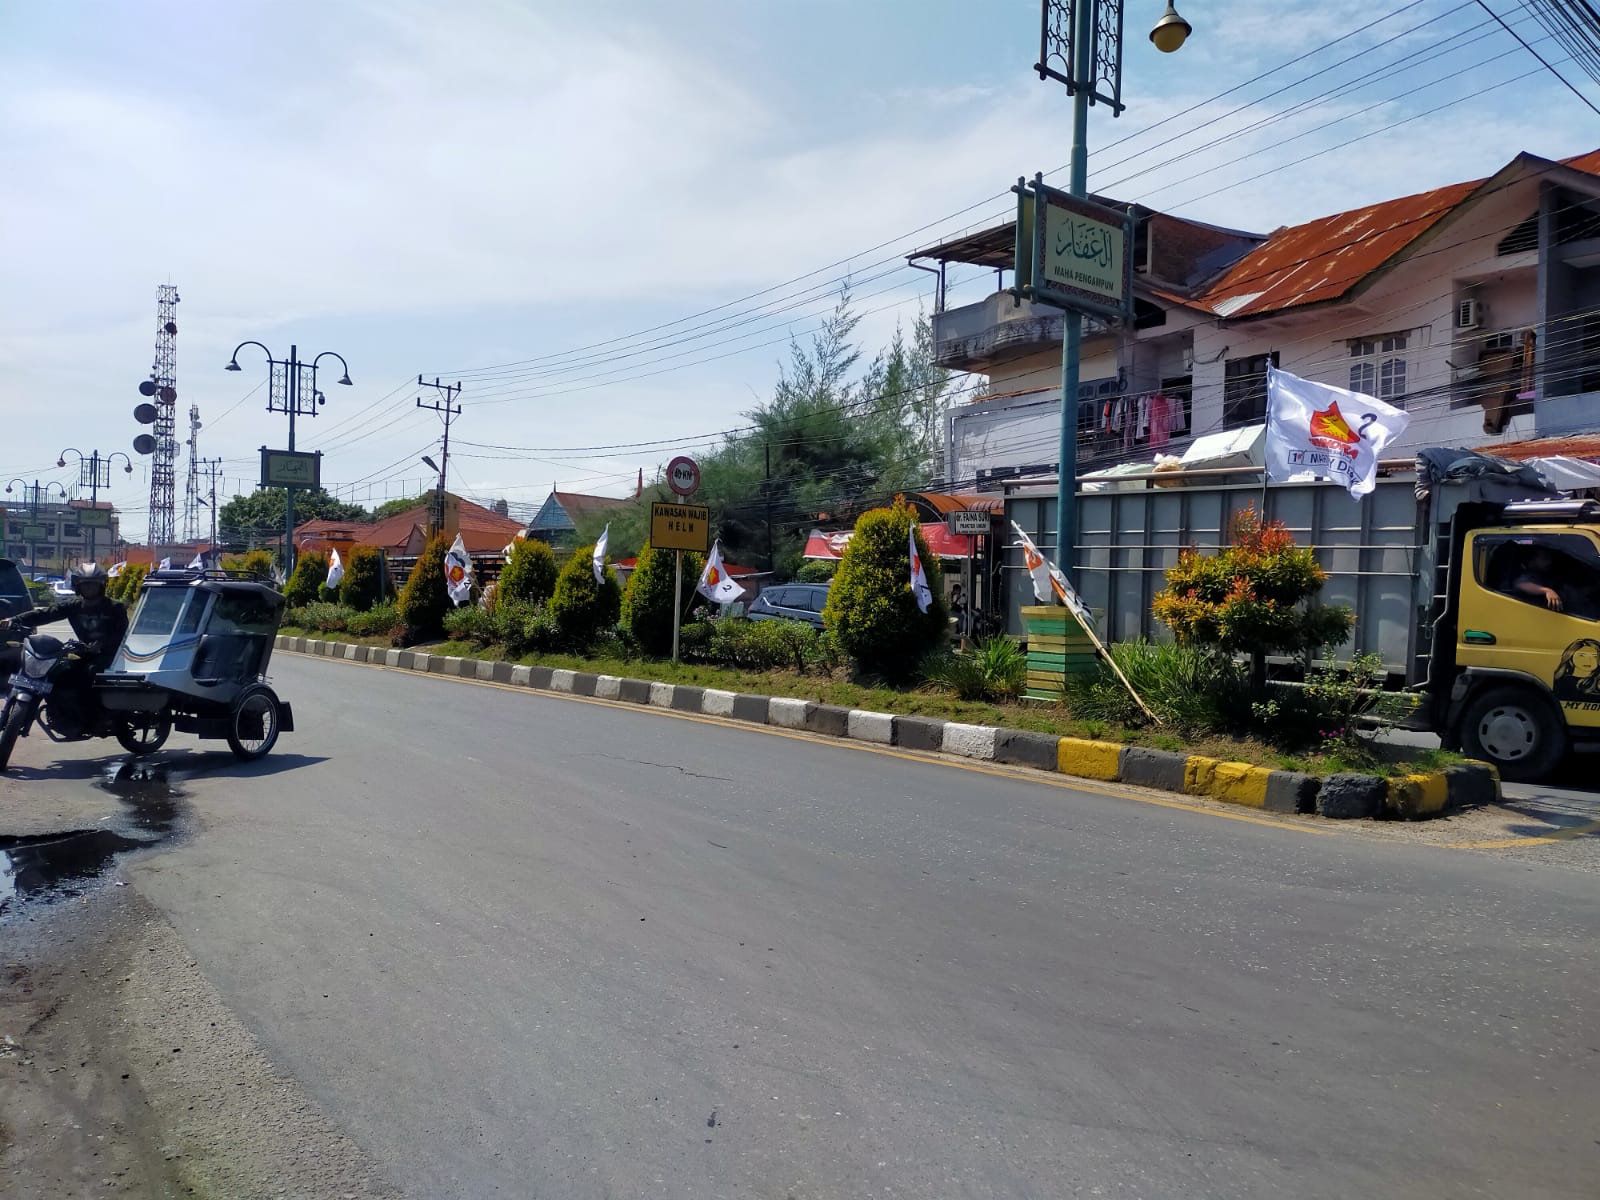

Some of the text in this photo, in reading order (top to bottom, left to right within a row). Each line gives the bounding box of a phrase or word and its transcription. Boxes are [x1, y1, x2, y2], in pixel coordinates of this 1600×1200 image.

[1054, 265, 1114, 291] MAHA PENGAMPUN
[1358, 412, 1378, 440] 2
[654, 506, 707, 521] KAWASAN WAJIB
[963, 512, 977, 522] FAINA
[1582, 703, 1600, 711] HO
